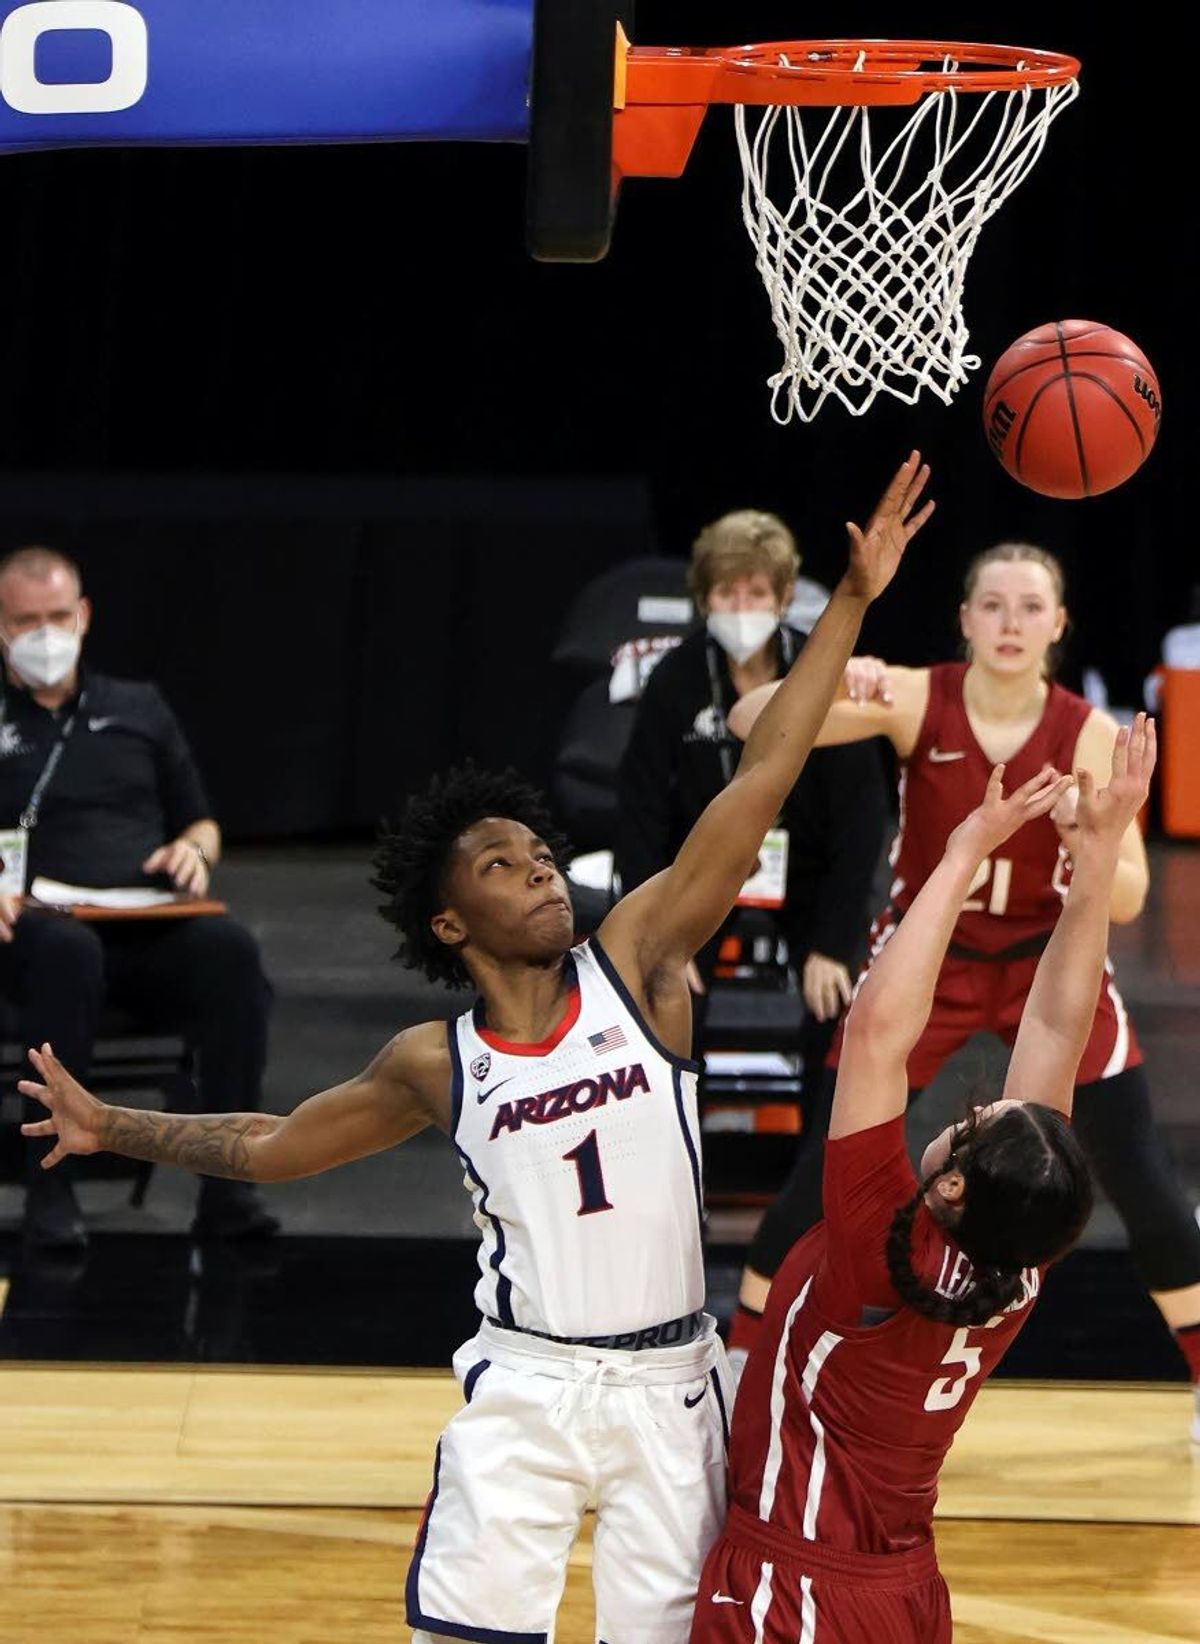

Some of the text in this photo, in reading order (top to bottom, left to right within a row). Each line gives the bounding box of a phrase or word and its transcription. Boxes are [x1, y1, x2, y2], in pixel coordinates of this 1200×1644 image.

[488, 1063, 651, 1141] ARIZONA
[562, 1128, 614, 1216] 1
[923, 1315, 1005, 1412] 5
